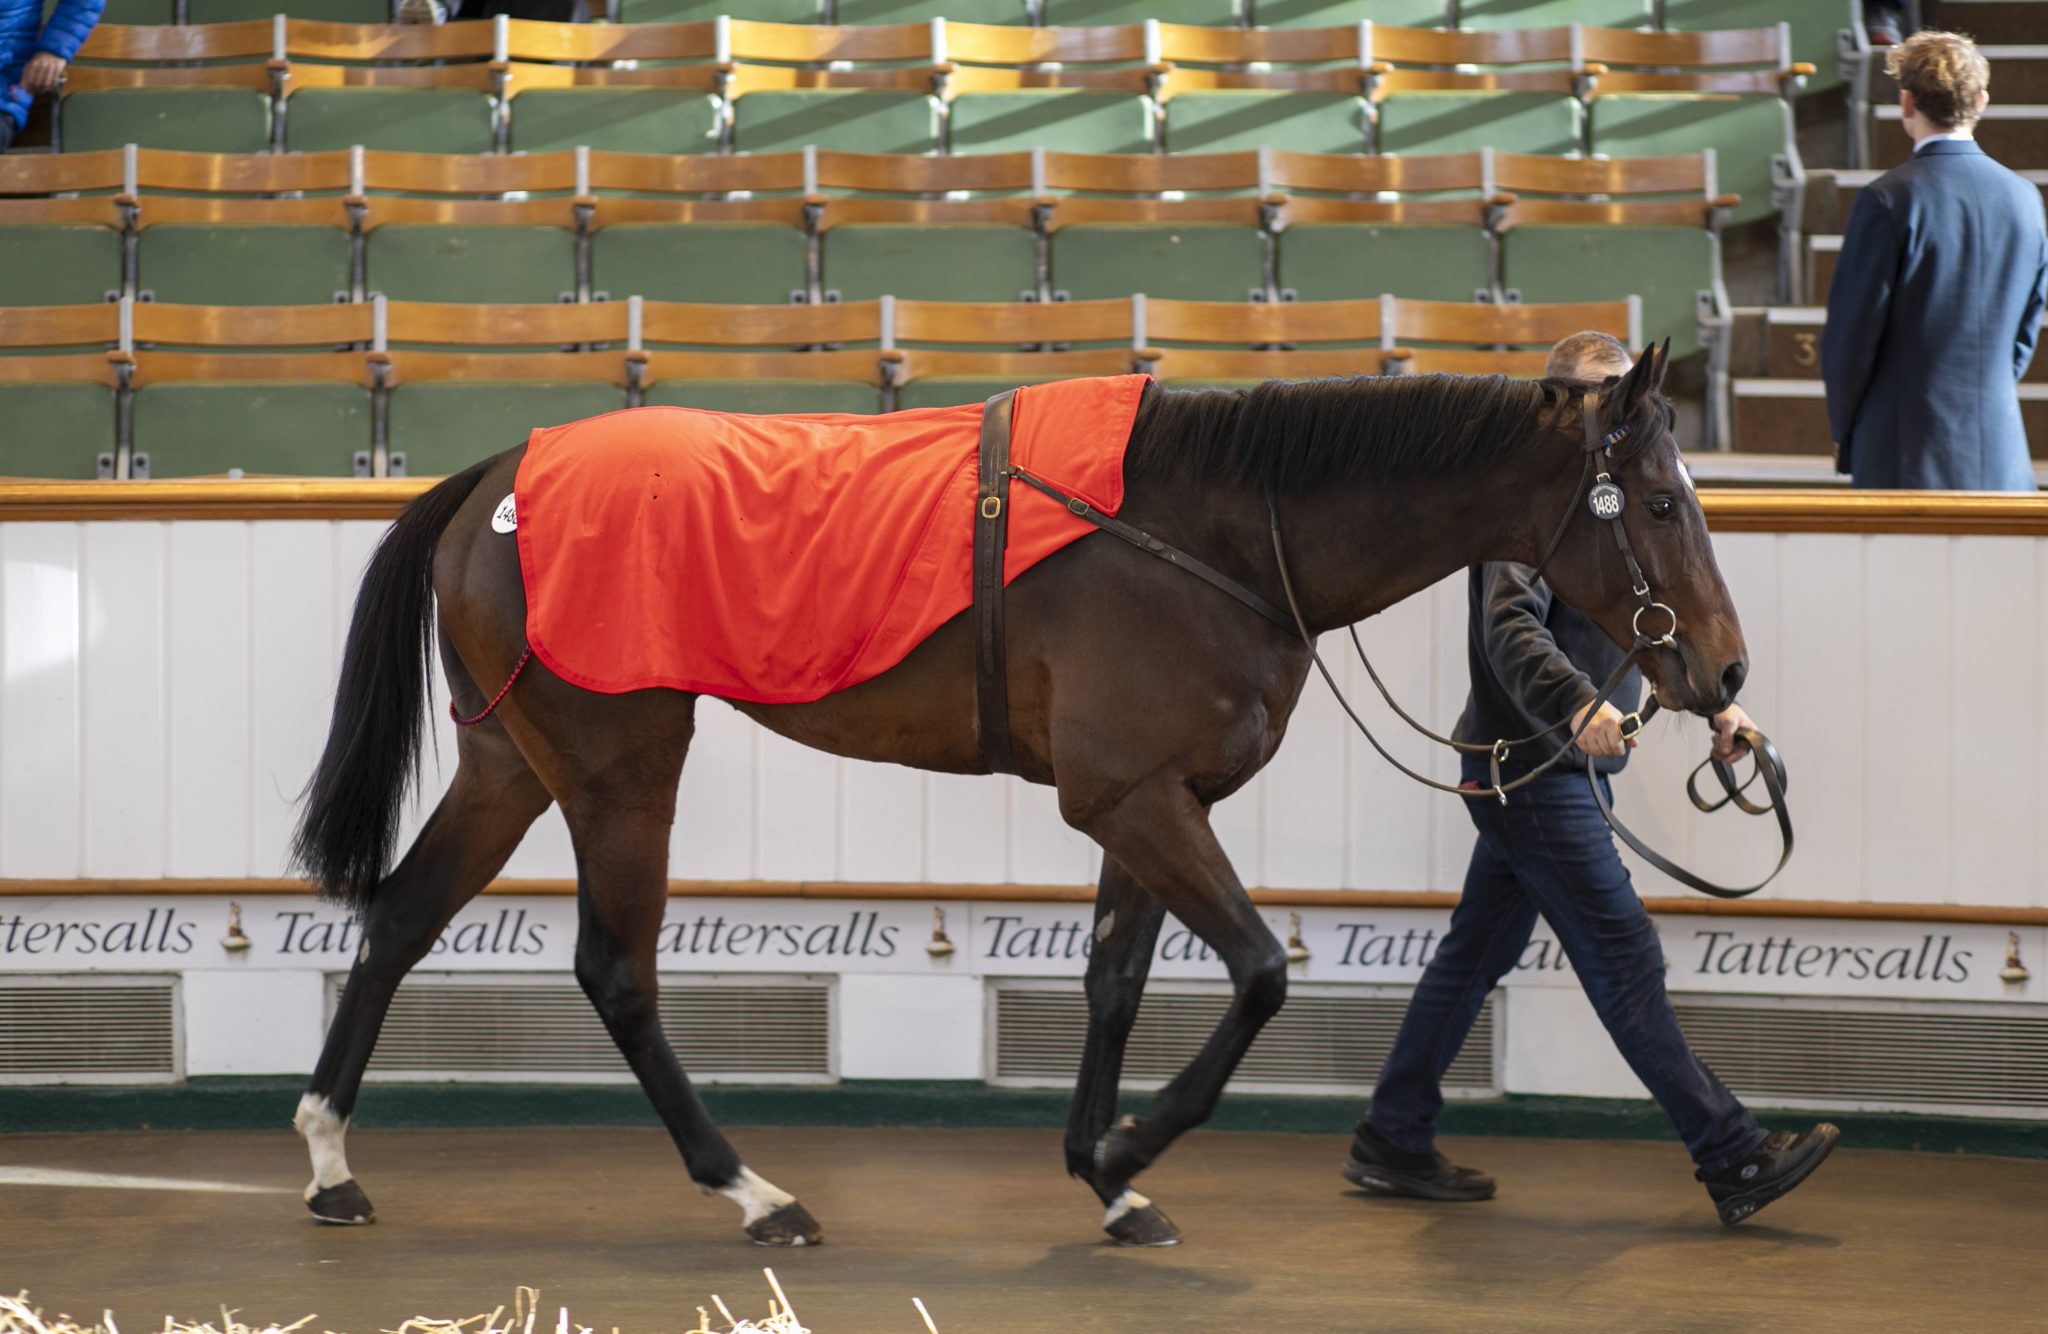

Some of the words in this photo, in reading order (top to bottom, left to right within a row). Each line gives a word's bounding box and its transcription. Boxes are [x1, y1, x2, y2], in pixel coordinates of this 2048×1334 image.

[1794, 333, 1816, 366] 3
[1593, 494, 1619, 515] 1488
[657, 911, 899, 957] attersalls
[1694, 931, 1973, 983] Tattersalls
